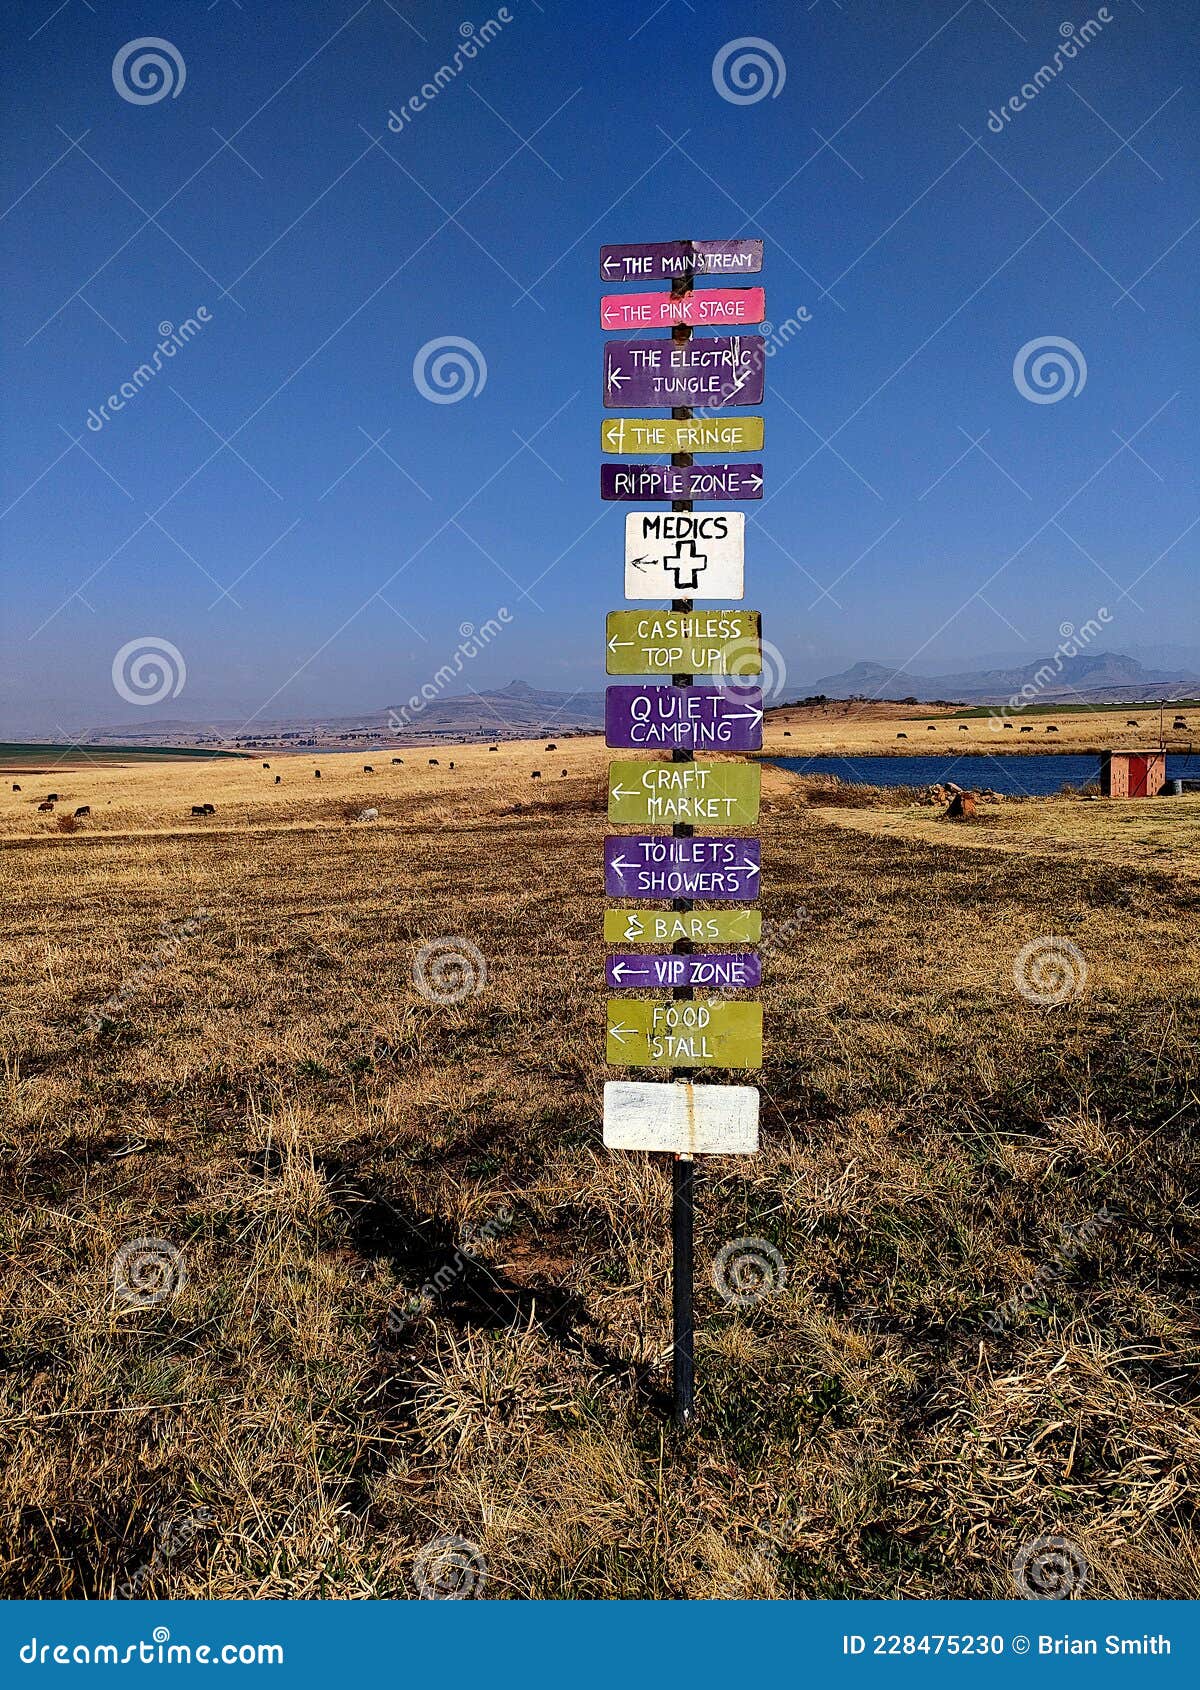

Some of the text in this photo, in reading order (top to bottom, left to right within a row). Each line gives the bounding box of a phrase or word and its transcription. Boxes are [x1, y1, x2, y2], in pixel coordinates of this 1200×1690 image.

[623, 253, 752, 274] THE MAINSTREAM
[620, 301, 745, 321] THE PINK STAGE
[629, 350, 751, 367] THE ELECTRIC
[653, 375, 721, 392] JUNGLE
[631, 427, 743, 445] THE FRINGE
[615, 473, 739, 494] RIPPLE ZONE
[642, 515, 728, 539] MEDICS
[637, 619, 742, 639] CASHLESS
[641, 647, 683, 667] TOP
[630, 696, 726, 722] QUIET
[630, 722, 733, 742] CAMPING
[642, 769, 711, 789] CRAFT
[647, 798, 737, 817] MARKET
[638, 843, 736, 862] TOILETS
[638, 871, 740, 892] SHOWERS
[655, 918, 720, 938] BARS
[654, 961, 745, 983] VIP ZONE
[652, 1007, 710, 1028] FOOD
[652, 1036, 714, 1058] STALL
